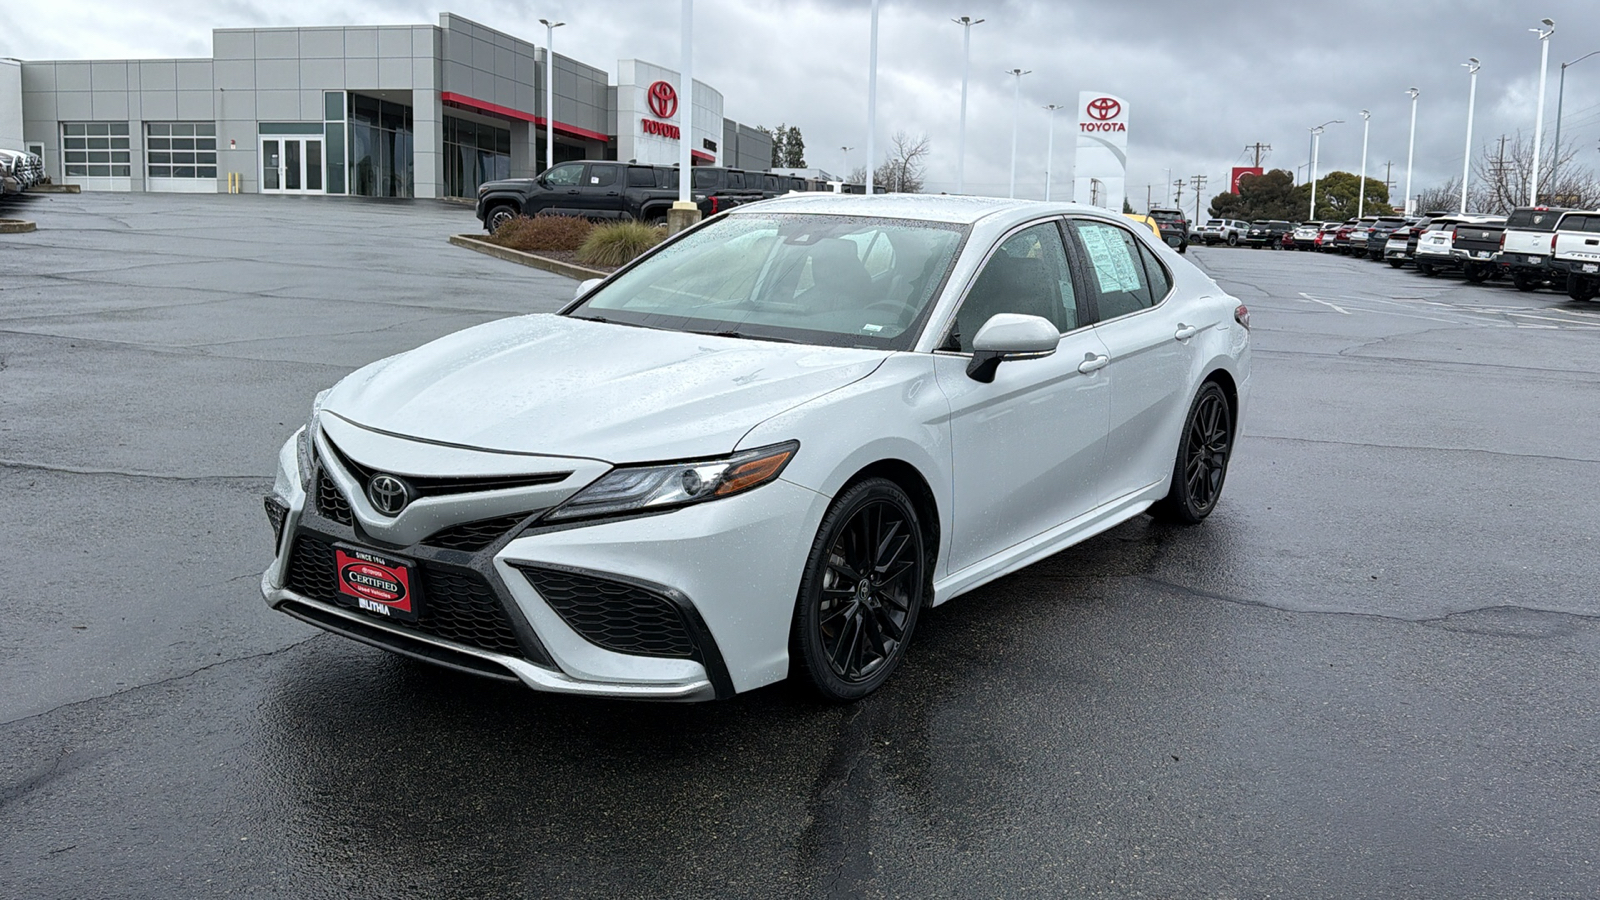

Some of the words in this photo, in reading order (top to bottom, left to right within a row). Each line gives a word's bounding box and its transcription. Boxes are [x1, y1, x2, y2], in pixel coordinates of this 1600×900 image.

[641, 118, 680, 140] TOYOTA
[1079, 122, 1126, 132] TOYOTA
[355, 552, 372, 561] SINCE
[357, 585, 371, 593] Used
[371, 589, 391, 599] Vehicles
[366, 599, 391, 616] LITHIA
